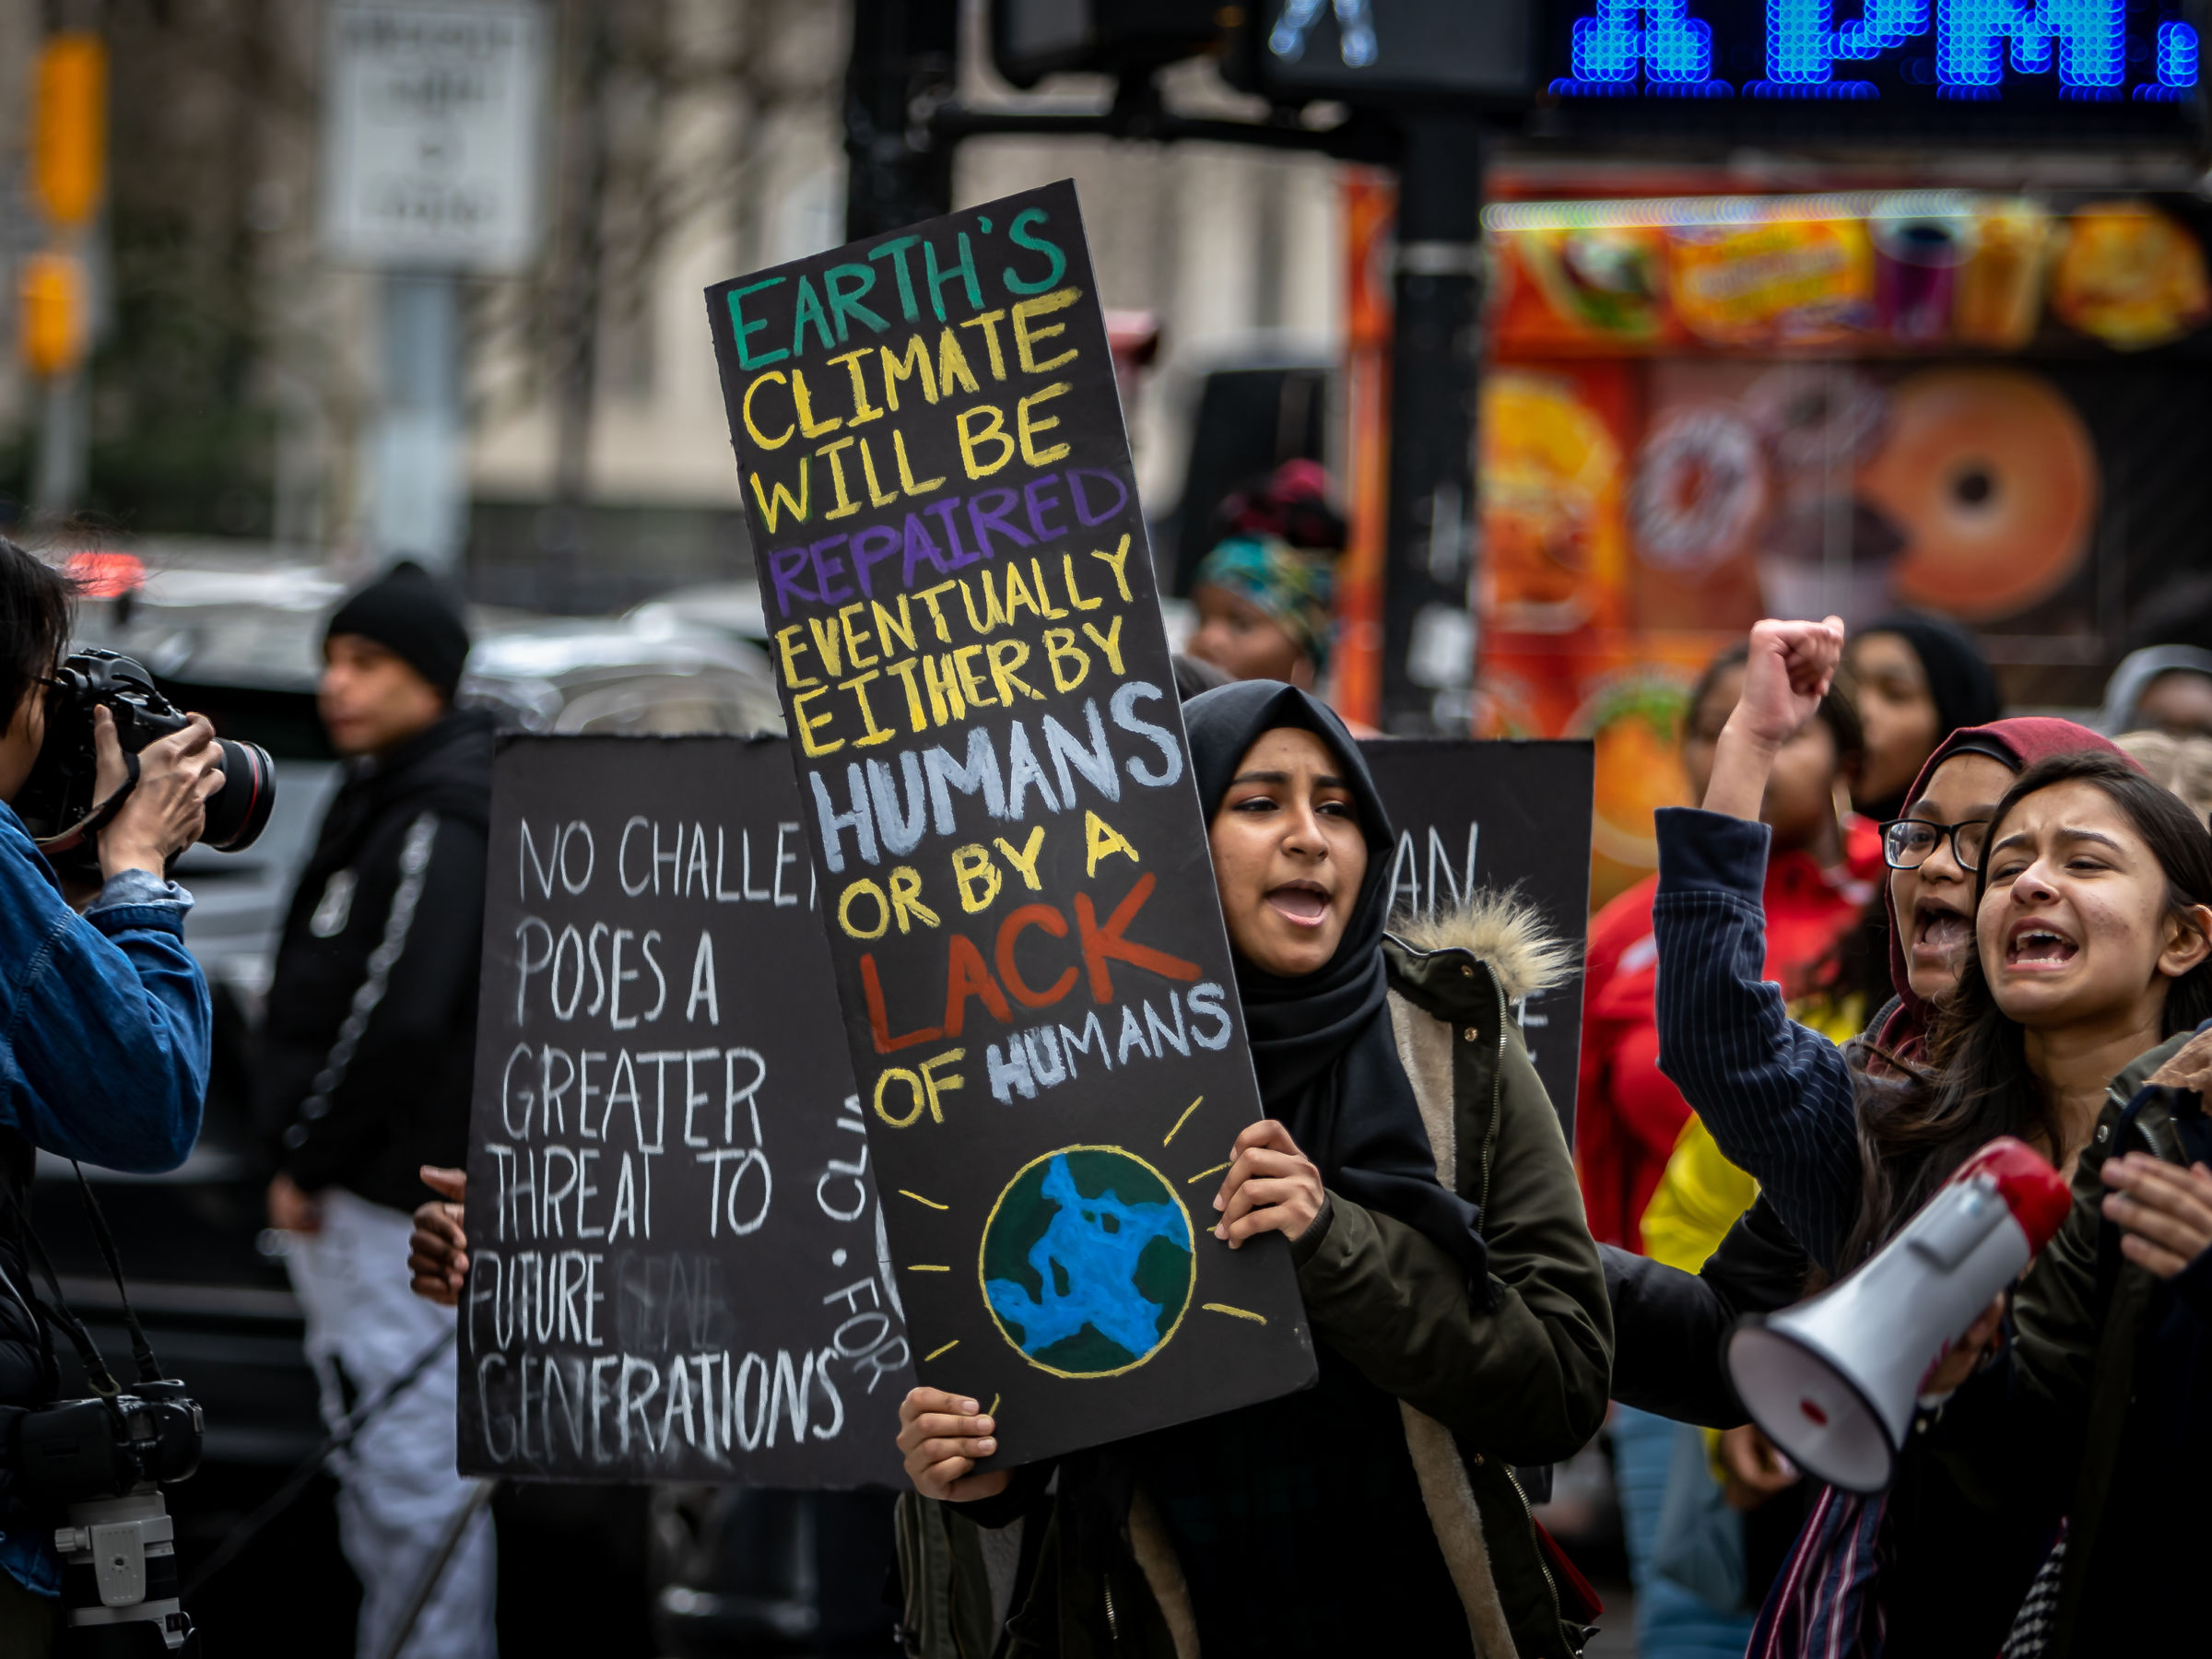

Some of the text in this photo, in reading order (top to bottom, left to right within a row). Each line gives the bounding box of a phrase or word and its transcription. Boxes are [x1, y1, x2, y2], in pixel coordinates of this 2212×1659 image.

[727, 206, 1066, 370] EARTH'S
[743, 286, 1083, 450] CLIMATE
[750, 382, 1073, 534] WILL BE
[768, 467, 1127, 618] REPAIRED
[775, 533, 1134, 688] EVENTUALLY
[793, 615, 1127, 758] EITHER BY
[808, 681, 1182, 874] HUMANS
[520, 815, 818, 912] NO CHALLE
[838, 810, 1140, 939] OR BY A
[515, 916, 719, 1030] POSES A
[860, 872, 1201, 1054] LACK
[502, 1042, 767, 1147] GREATER
[873, 982, 1233, 1128] OF HUMANS
[484, 1144, 772, 1244] THREAT TO
[468, 1250, 605, 1355] FUTURE
[823, 1276, 910, 1394] FOR
[477, 1347, 844, 1464] GENERATIONS
